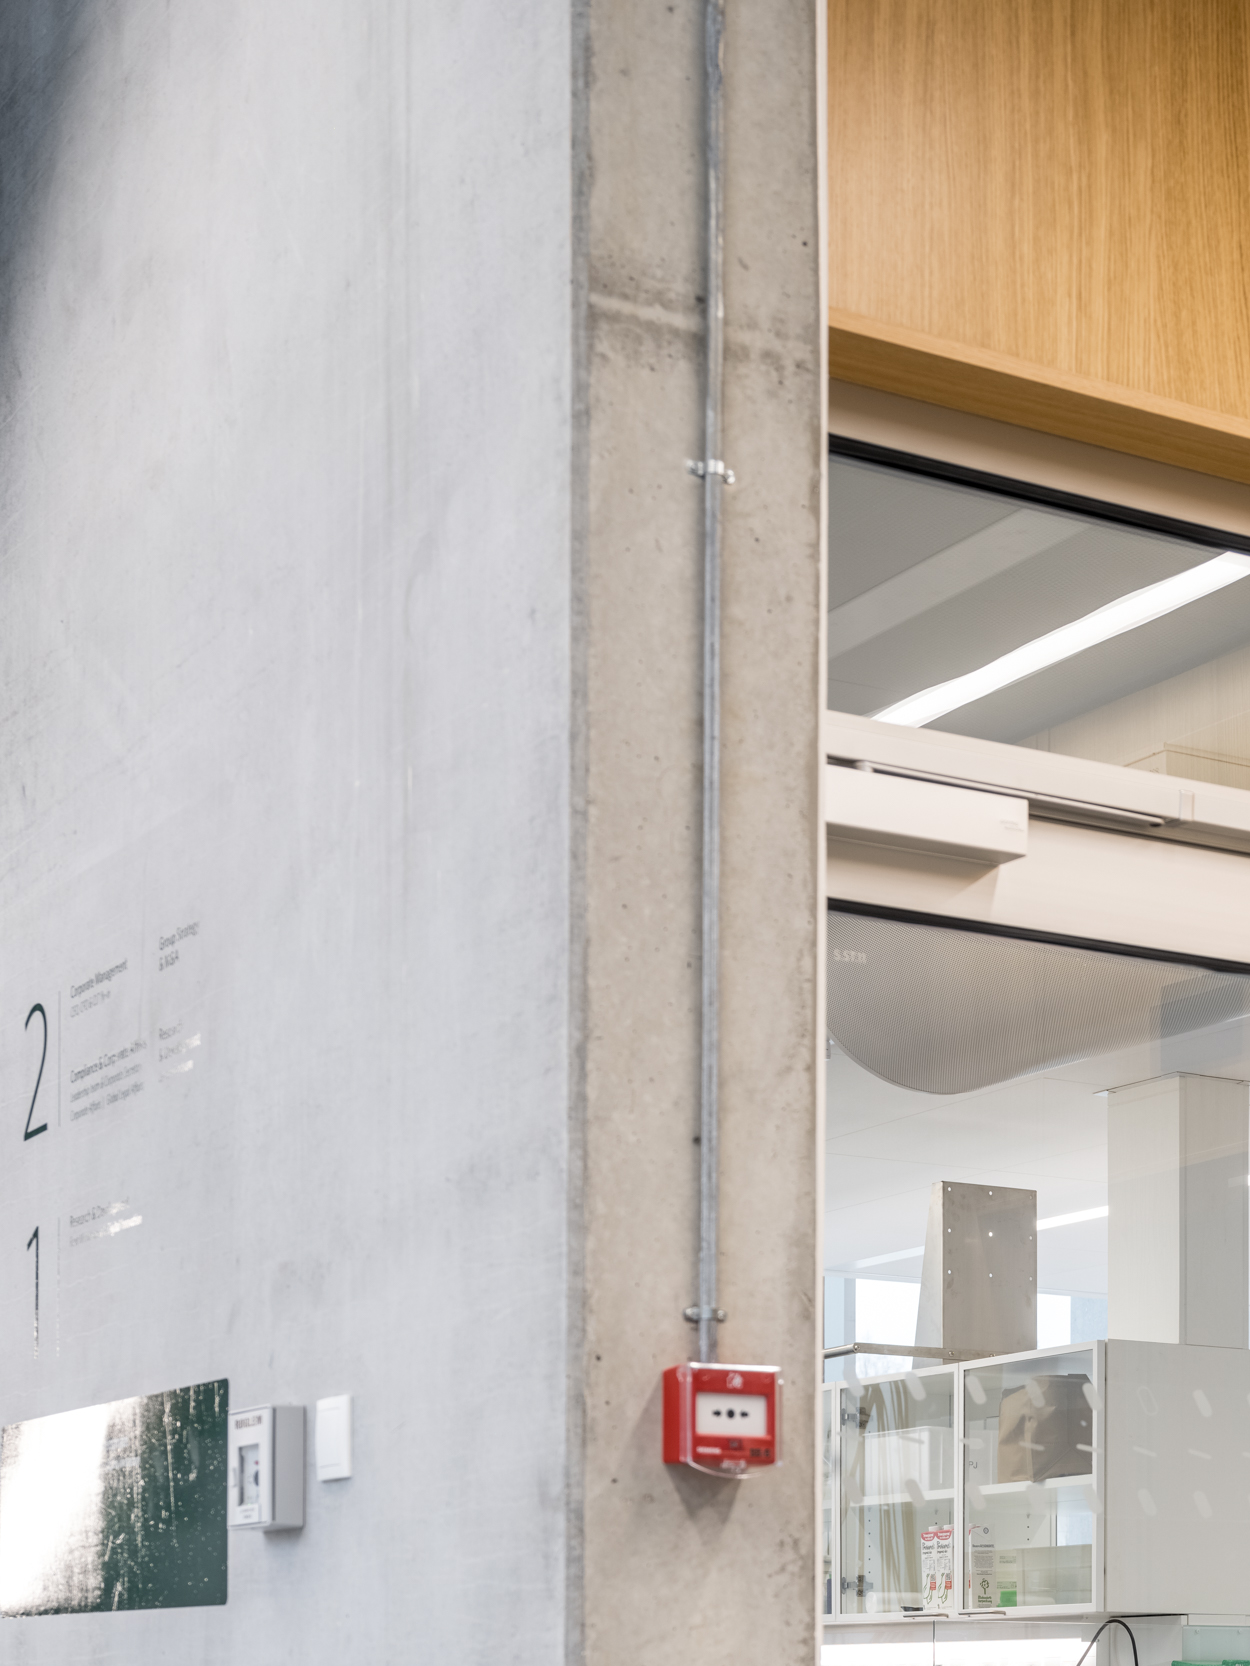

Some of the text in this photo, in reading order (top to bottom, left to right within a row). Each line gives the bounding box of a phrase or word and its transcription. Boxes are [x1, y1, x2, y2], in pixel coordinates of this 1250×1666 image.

[95, 958, 128, 984] Management
[24, 1002, 48, 1141] 2
[27, 1226, 39, 1357] 1
